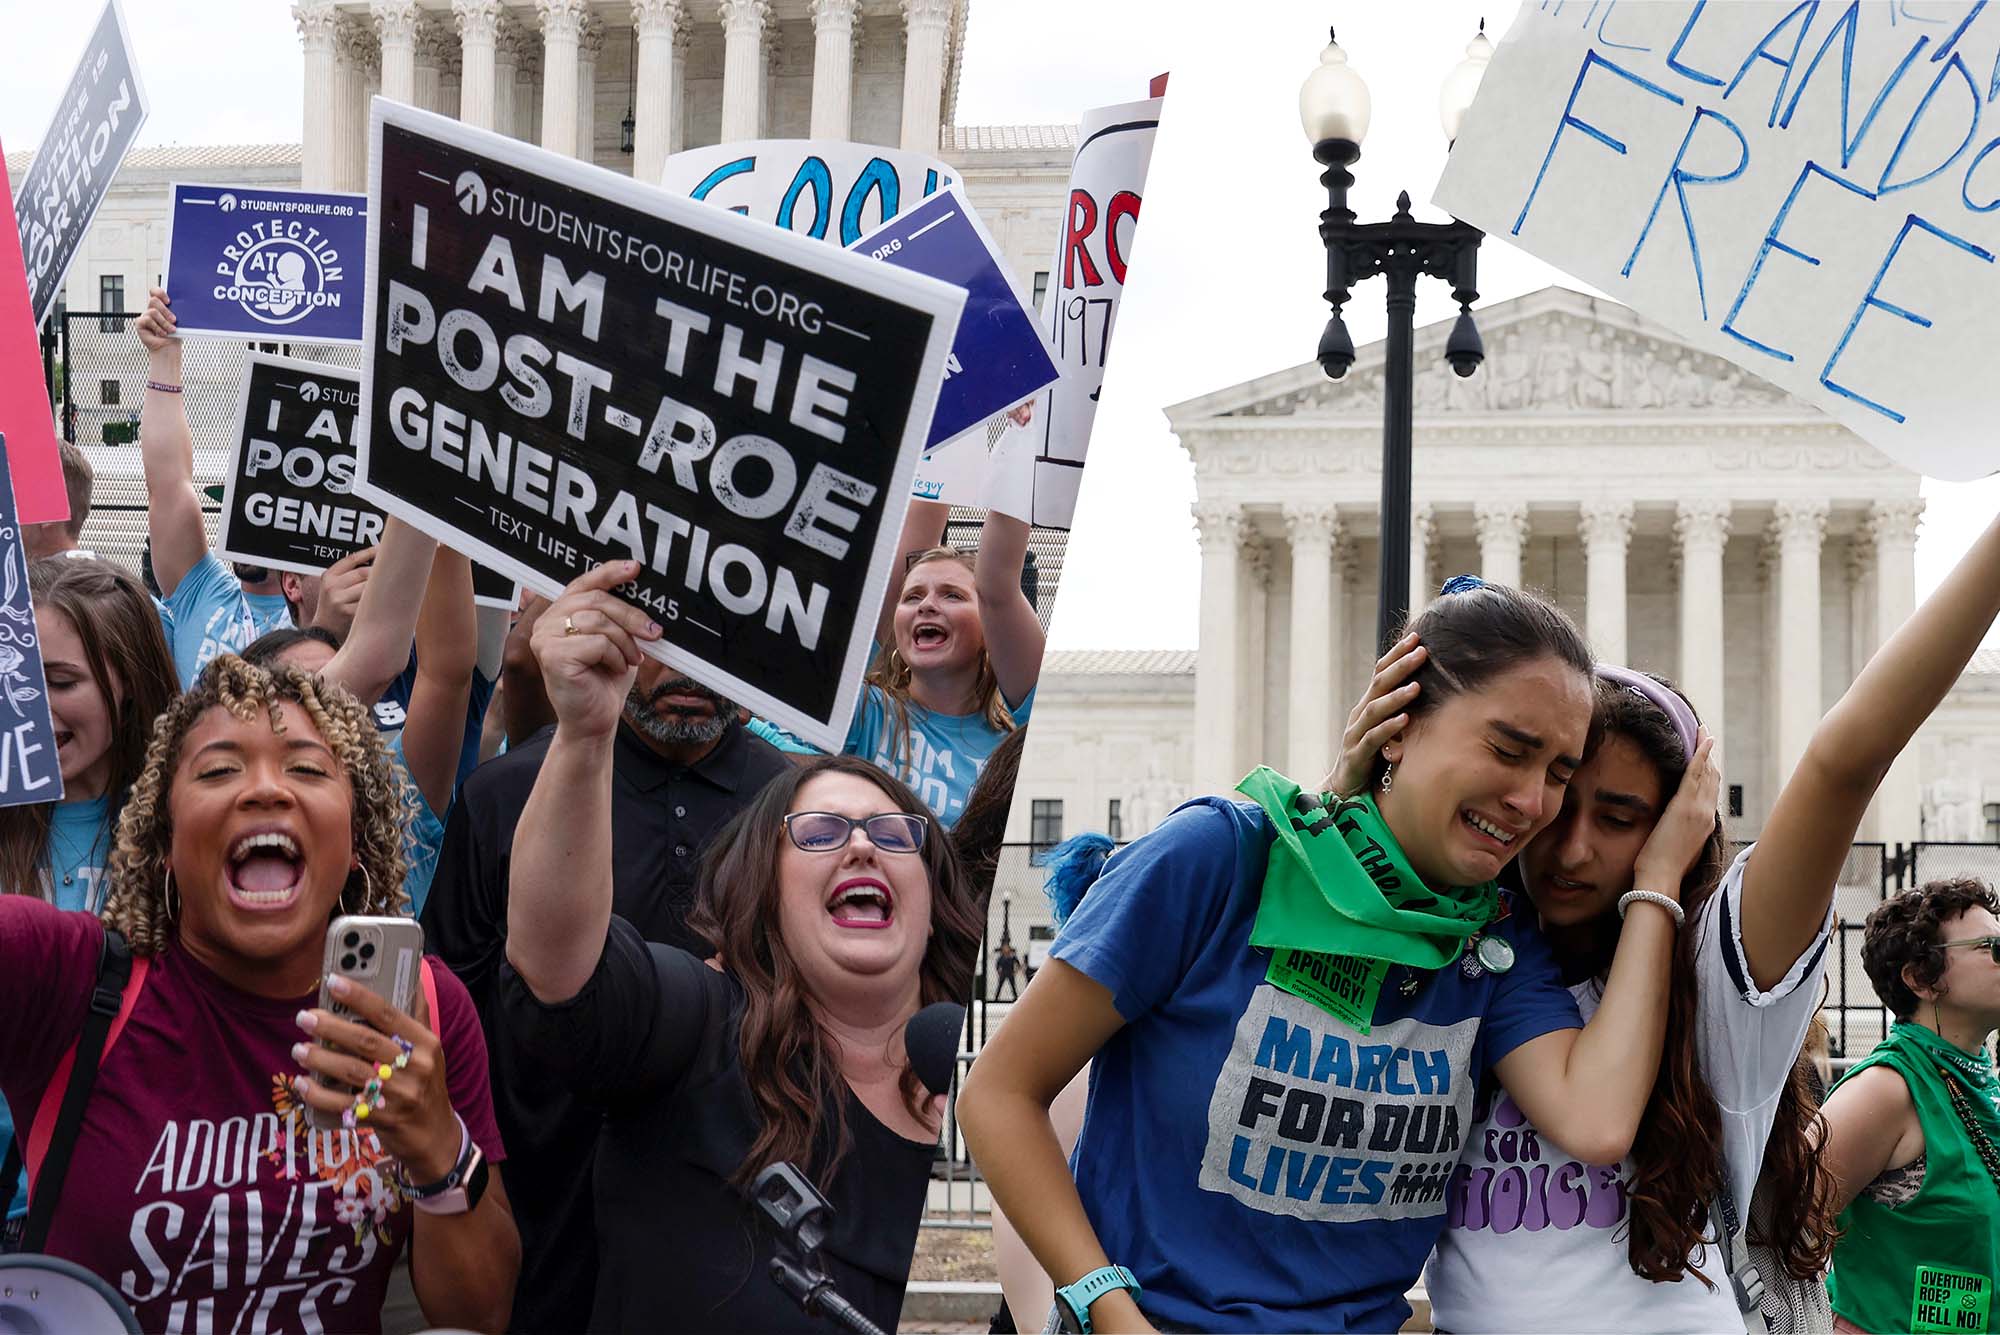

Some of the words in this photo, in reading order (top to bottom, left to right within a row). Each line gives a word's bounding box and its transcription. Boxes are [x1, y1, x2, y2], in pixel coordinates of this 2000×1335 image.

[33, 87, 89, 211] FUTURE
[92, 48, 108, 85] IS
[29, 121, 91, 265] ANTI-
[240, 199, 354, 217] STUDENTSFORLIFE.ORG
[216, 219, 344, 282] PROTECTION
[250, 251, 278, 272] AT
[491, 188, 824, 335] STUDENTSFORLIFE.ORG
[1511, 48, 1995, 424] FREE
[213, 285, 341, 308] CONCEPTION
[411, 203, 429, 271] I
[467, 234, 606, 343] AM
[655, 297, 857, 444] THE
[267, 399, 281, 432] I
[386, 279, 878, 561] POST-ROE
[245, 438, 357, 495] POS
[245, 492, 384, 545] GENER
[389, 386, 830, 651] GENERATION
[489, 505, 533, 543] TEXT
[537, 532, 577, 569] LIFE
[313, 545, 343, 560] TEXT
[1286, 950, 1367, 1010] APOLOGY!
[1254, 1016, 1452, 1096] MARCH
[1238, 1076, 1365, 1149] FOR
[1367, 1102, 1461, 1153] OUR
[1484, 1128, 1541, 1163] FOR
[1227, 1133, 1394, 1206] LIVES
[121, 1168, 378, 1302] SAVES
[1919, 1286, 1951, 1305] ROE?
[1921, 1270, 1983, 1293] OVERTURN
[1917, 1303, 1952, 1327] HELL
[1956, 1309, 1982, 1330] NO!
